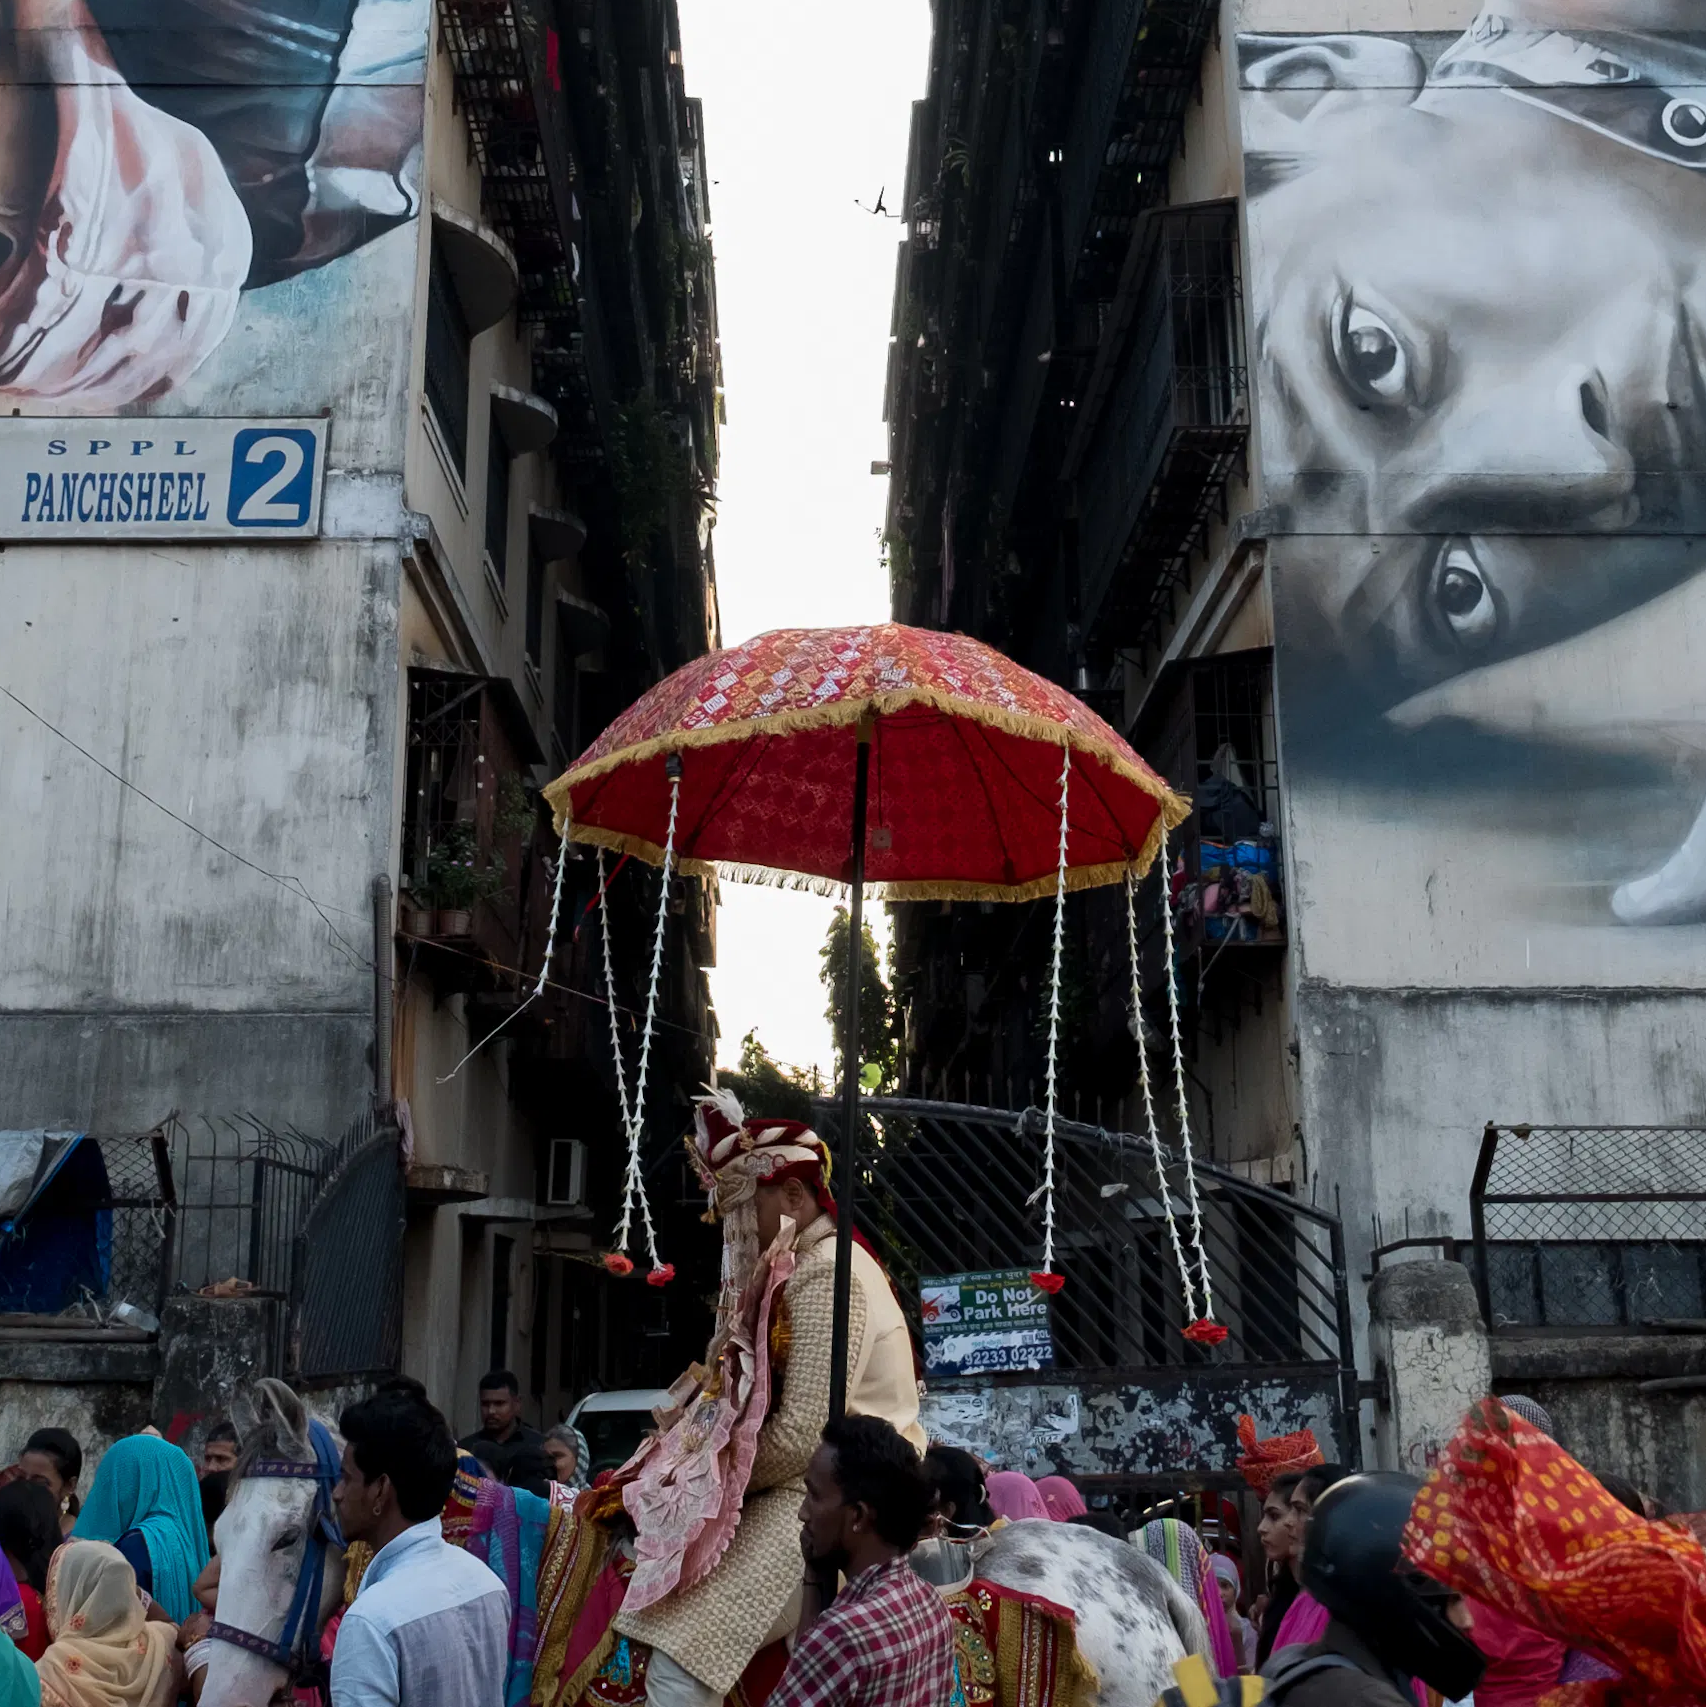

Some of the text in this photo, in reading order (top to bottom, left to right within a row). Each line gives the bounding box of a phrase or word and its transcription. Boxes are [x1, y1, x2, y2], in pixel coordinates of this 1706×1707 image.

[237, 436, 304, 521] 2
[21, 472, 210, 523] PANCHSHEEL
[975, 1290, 998, 1304] Do
[1003, 1287, 1033, 1301] Not
[964, 1302, 1048, 1321] Park Here
[964, 1346, 1052, 1365] 92233 02222
